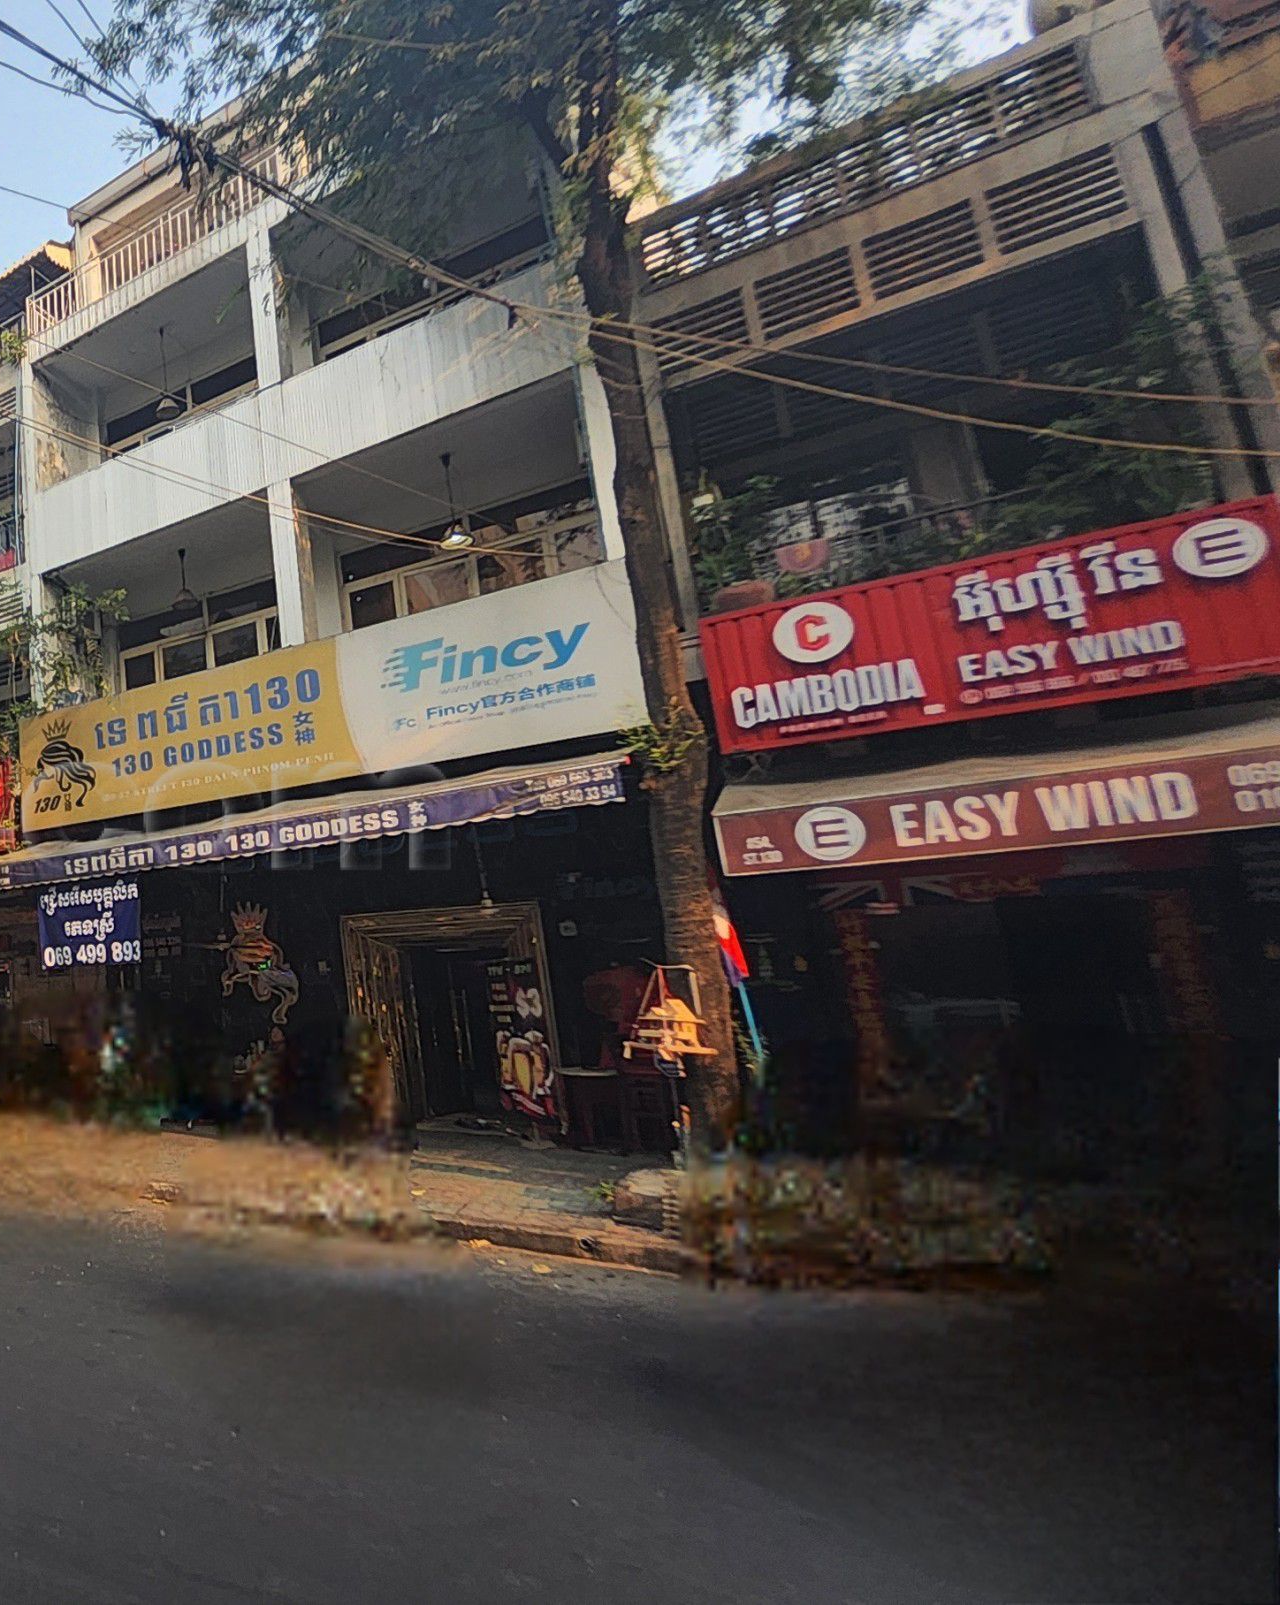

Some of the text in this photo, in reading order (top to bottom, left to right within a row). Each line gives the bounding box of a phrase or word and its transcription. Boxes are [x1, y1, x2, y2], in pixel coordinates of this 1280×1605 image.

[384, 622, 591, 693] Fincy
[958, 641, 1060, 684] EASY
[1067, 620, 1186, 665] WIND
[730, 657, 927, 729] CAMBODIA
[112, 722, 284, 777] 130 GODDESS
[33, 795, 62, 814] 130
[889, 771, 1199, 847] EASY WIND
[165, 839, 213, 861] 130
[225, 827, 271, 849] 130
[278, 808, 400, 842] GODDESS
[43, 940, 141, 967] 069 499 893
